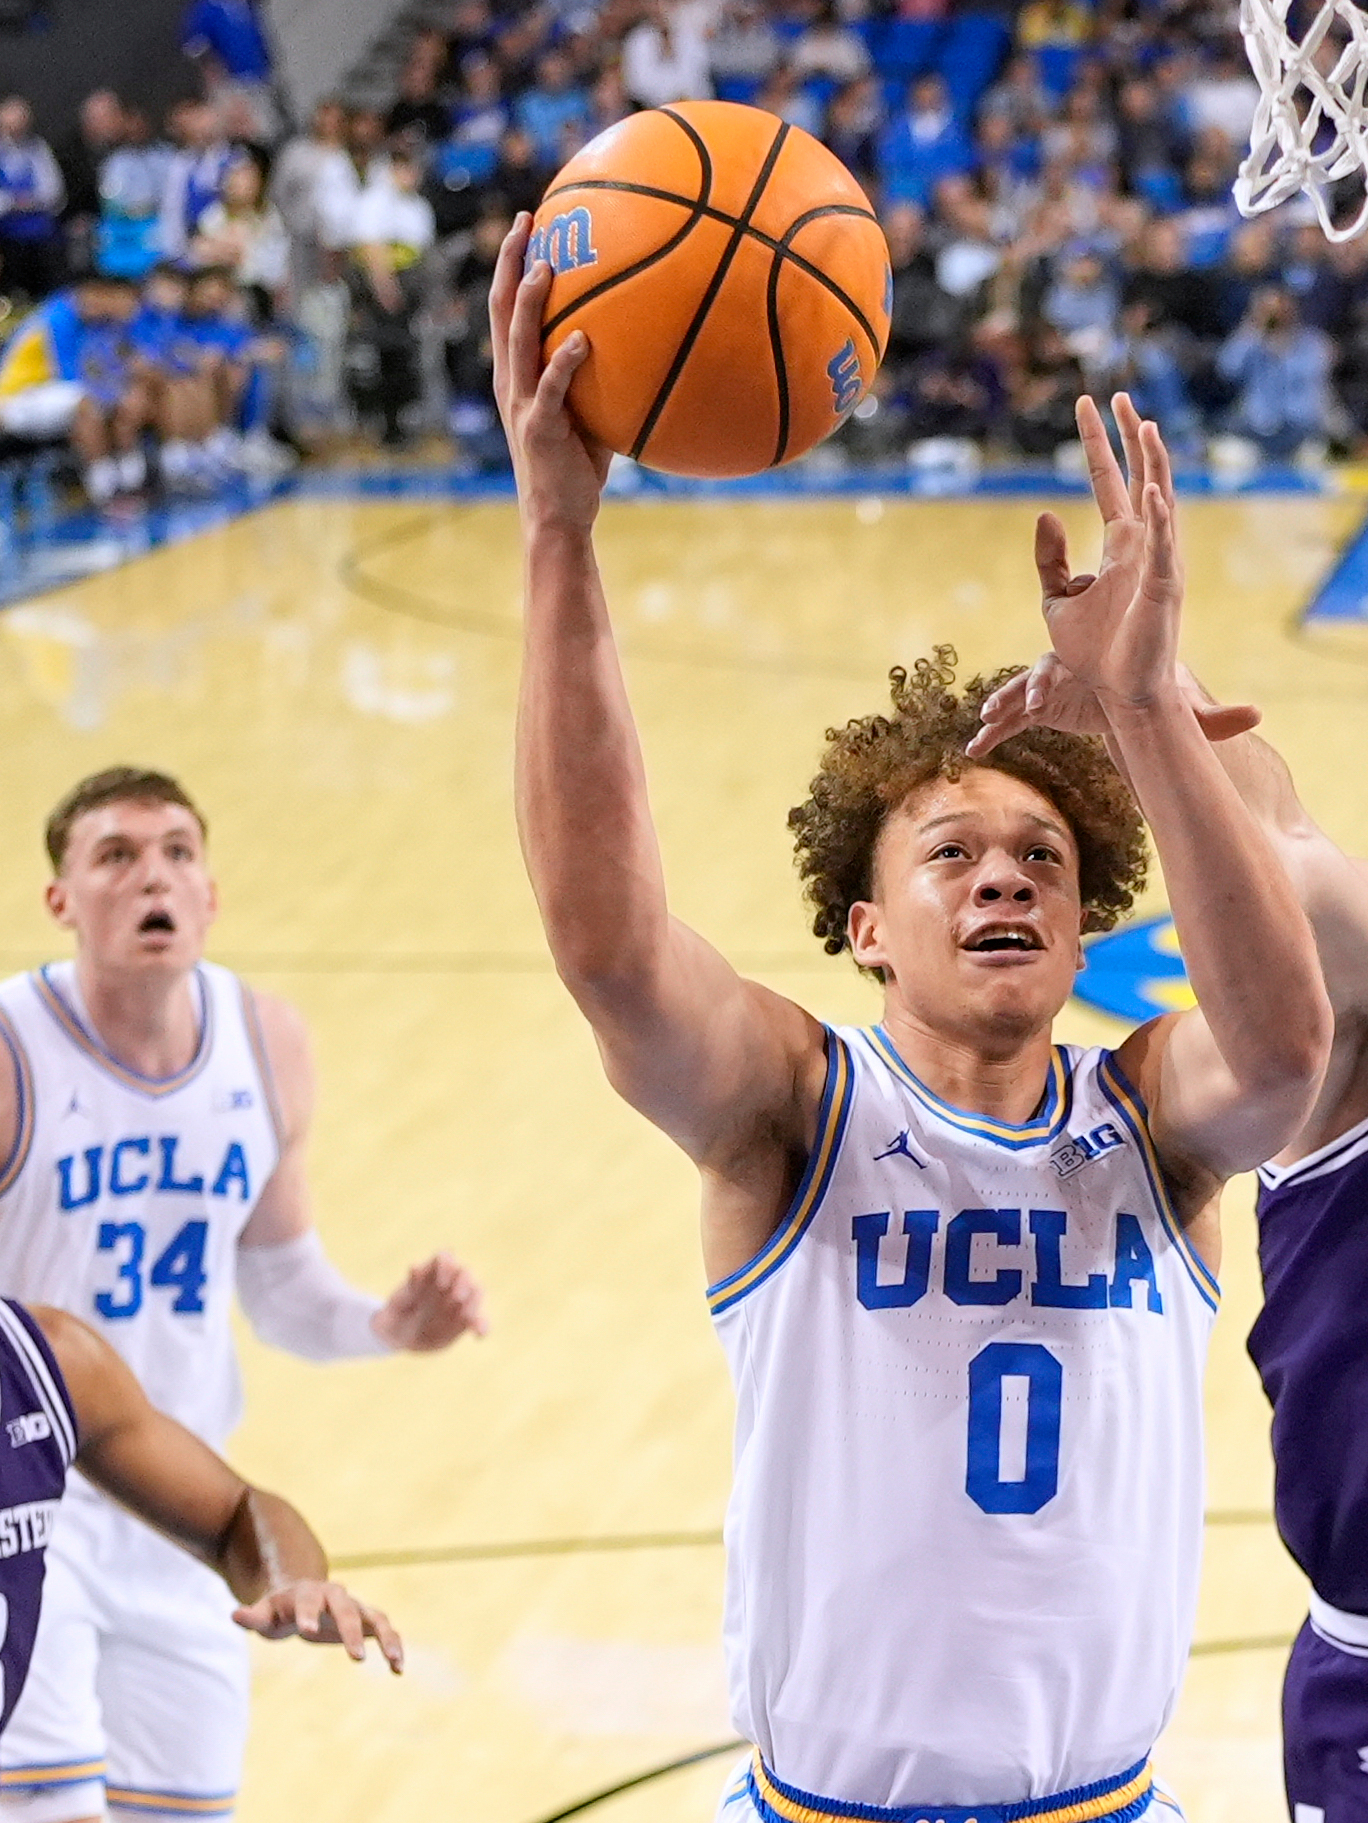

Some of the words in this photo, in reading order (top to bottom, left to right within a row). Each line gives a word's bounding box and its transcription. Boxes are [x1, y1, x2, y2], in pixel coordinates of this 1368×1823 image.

[57, 1136, 250, 1212] UCLA
[95, 1220, 209, 1320] 34
[851, 1208, 1164, 1315] UCLA
[965, 1341, 1063, 1515] 0
